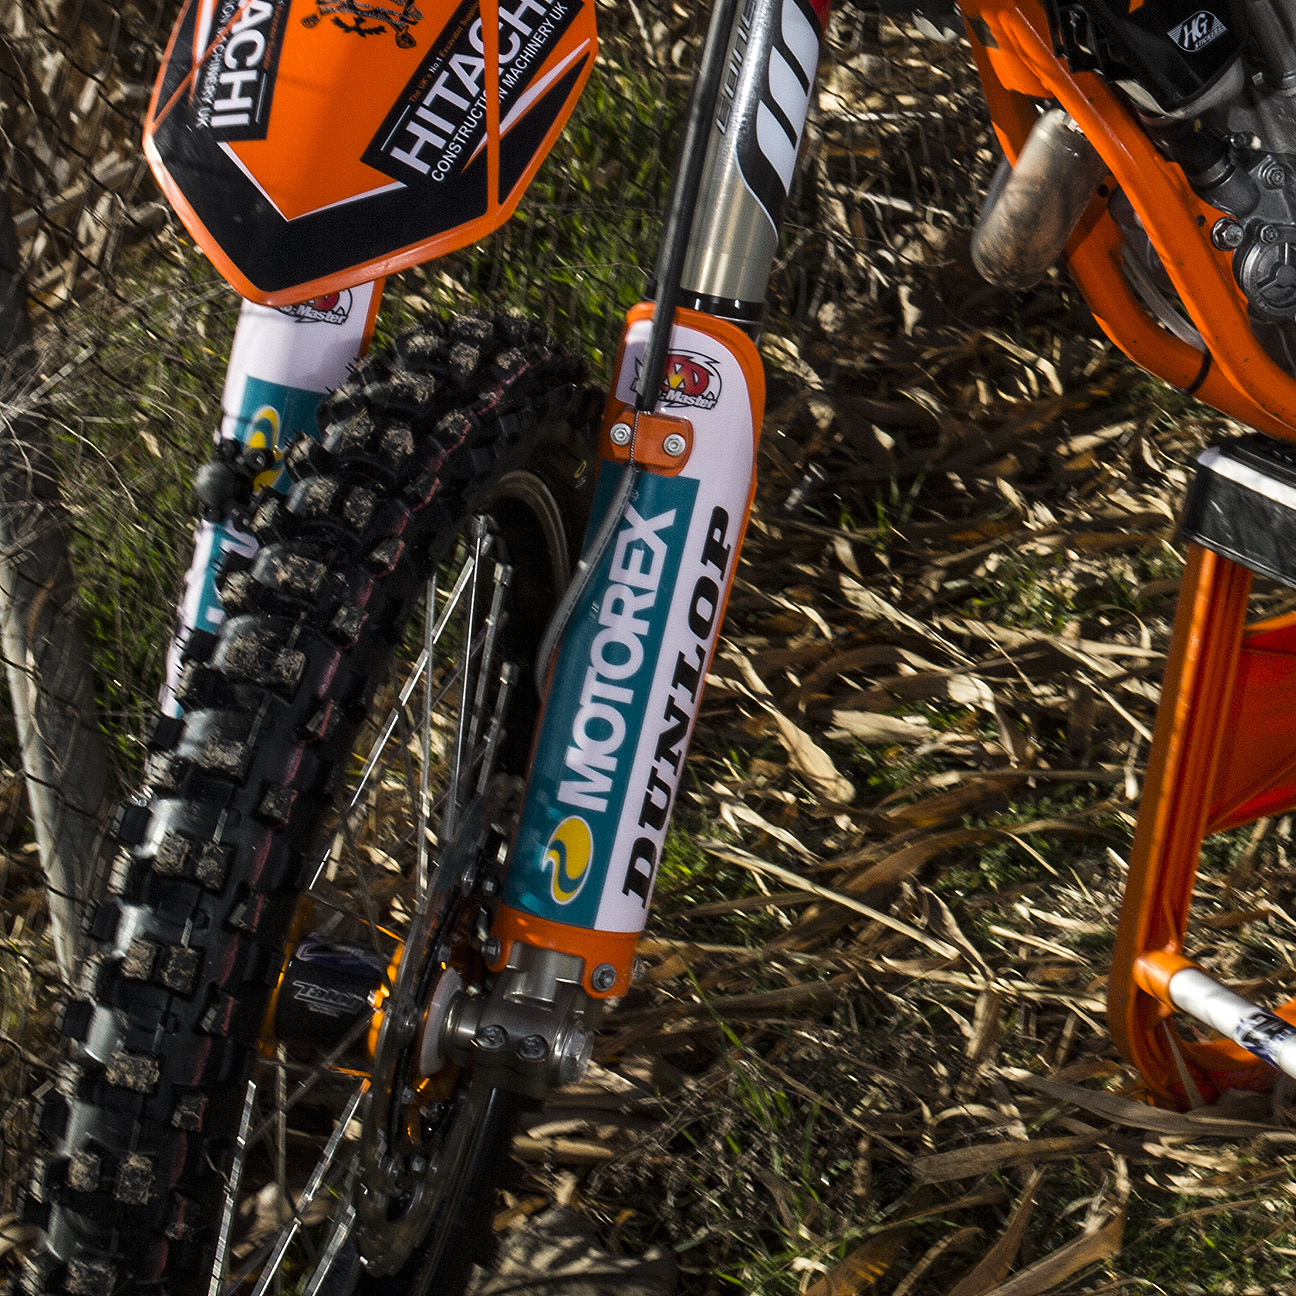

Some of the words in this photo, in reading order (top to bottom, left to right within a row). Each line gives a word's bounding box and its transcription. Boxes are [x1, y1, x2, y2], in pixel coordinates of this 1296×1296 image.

[429, 57, 444, 74] No.1
[503, 19, 555, 88] MACHINERY
[552, 1, 569, 22] UK
[557, 507, 678, 813] MOTOREX
[622, 505, 731, 909] DUNLOP
